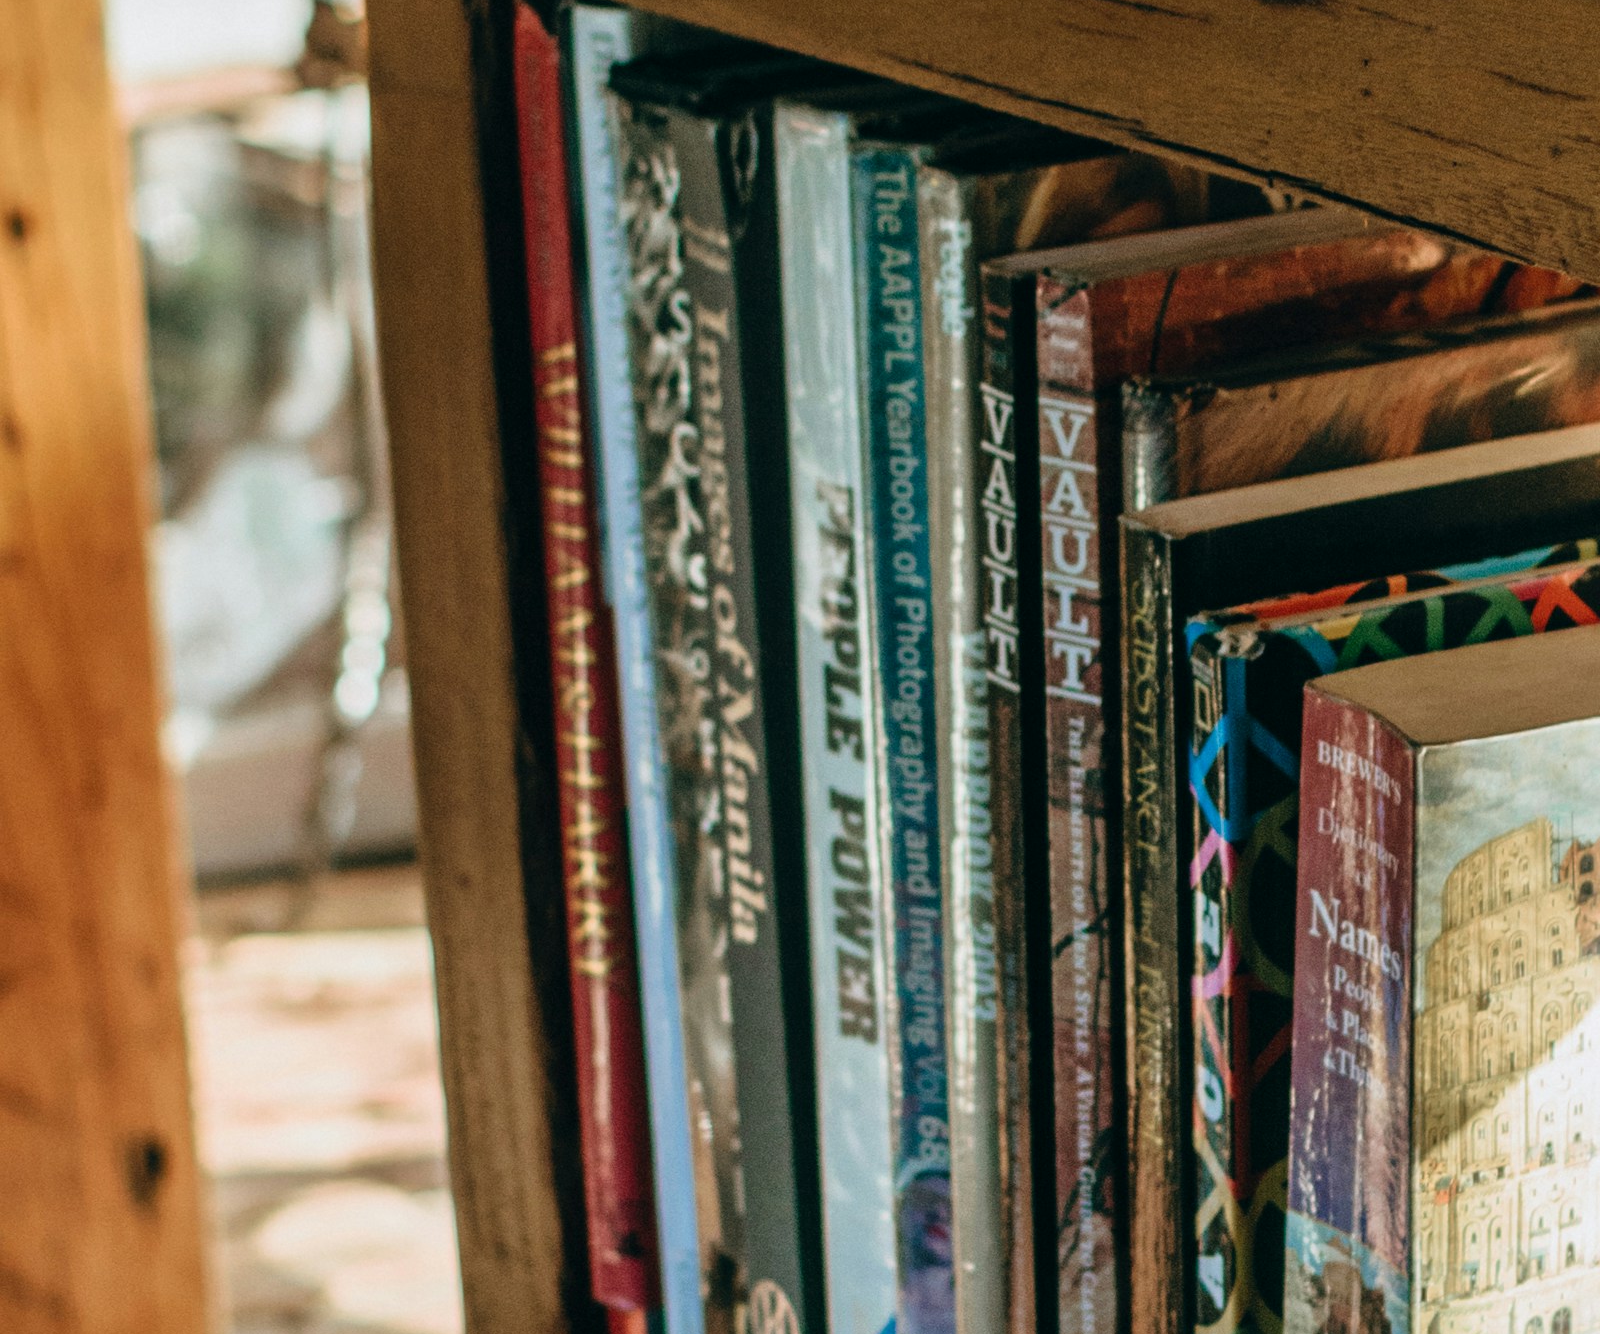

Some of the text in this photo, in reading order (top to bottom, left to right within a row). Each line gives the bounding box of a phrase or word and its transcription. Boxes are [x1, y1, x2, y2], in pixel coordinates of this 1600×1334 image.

[874, 165, 910, 234] The
[877, 243, 917, 376] AAPPL
[936, 218, 975, 339] People
[696, 307, 734, 576] Images
[884, 379, 925, 541] Yearbook
[895, 551, 924, 589] of
[980, 383, 1021, 693] VAULT
[1040, 401, 1102, 698] VAULT
[711, 581, 756, 681] of
[816, 480, 882, 1046] PEOPLE POWER
[893, 597, 936, 819] Photography
[715, 687, 768, 946] Manila
[1317, 739, 1402, 805] BREWER'S
[903, 829, 938, 897] and
[1316, 807, 1400, 880] Dictionary
[905, 904, 944, 1046] Imaging
[1308, 888, 1401, 983] Names
[915, 1116, 949, 1160] 68
